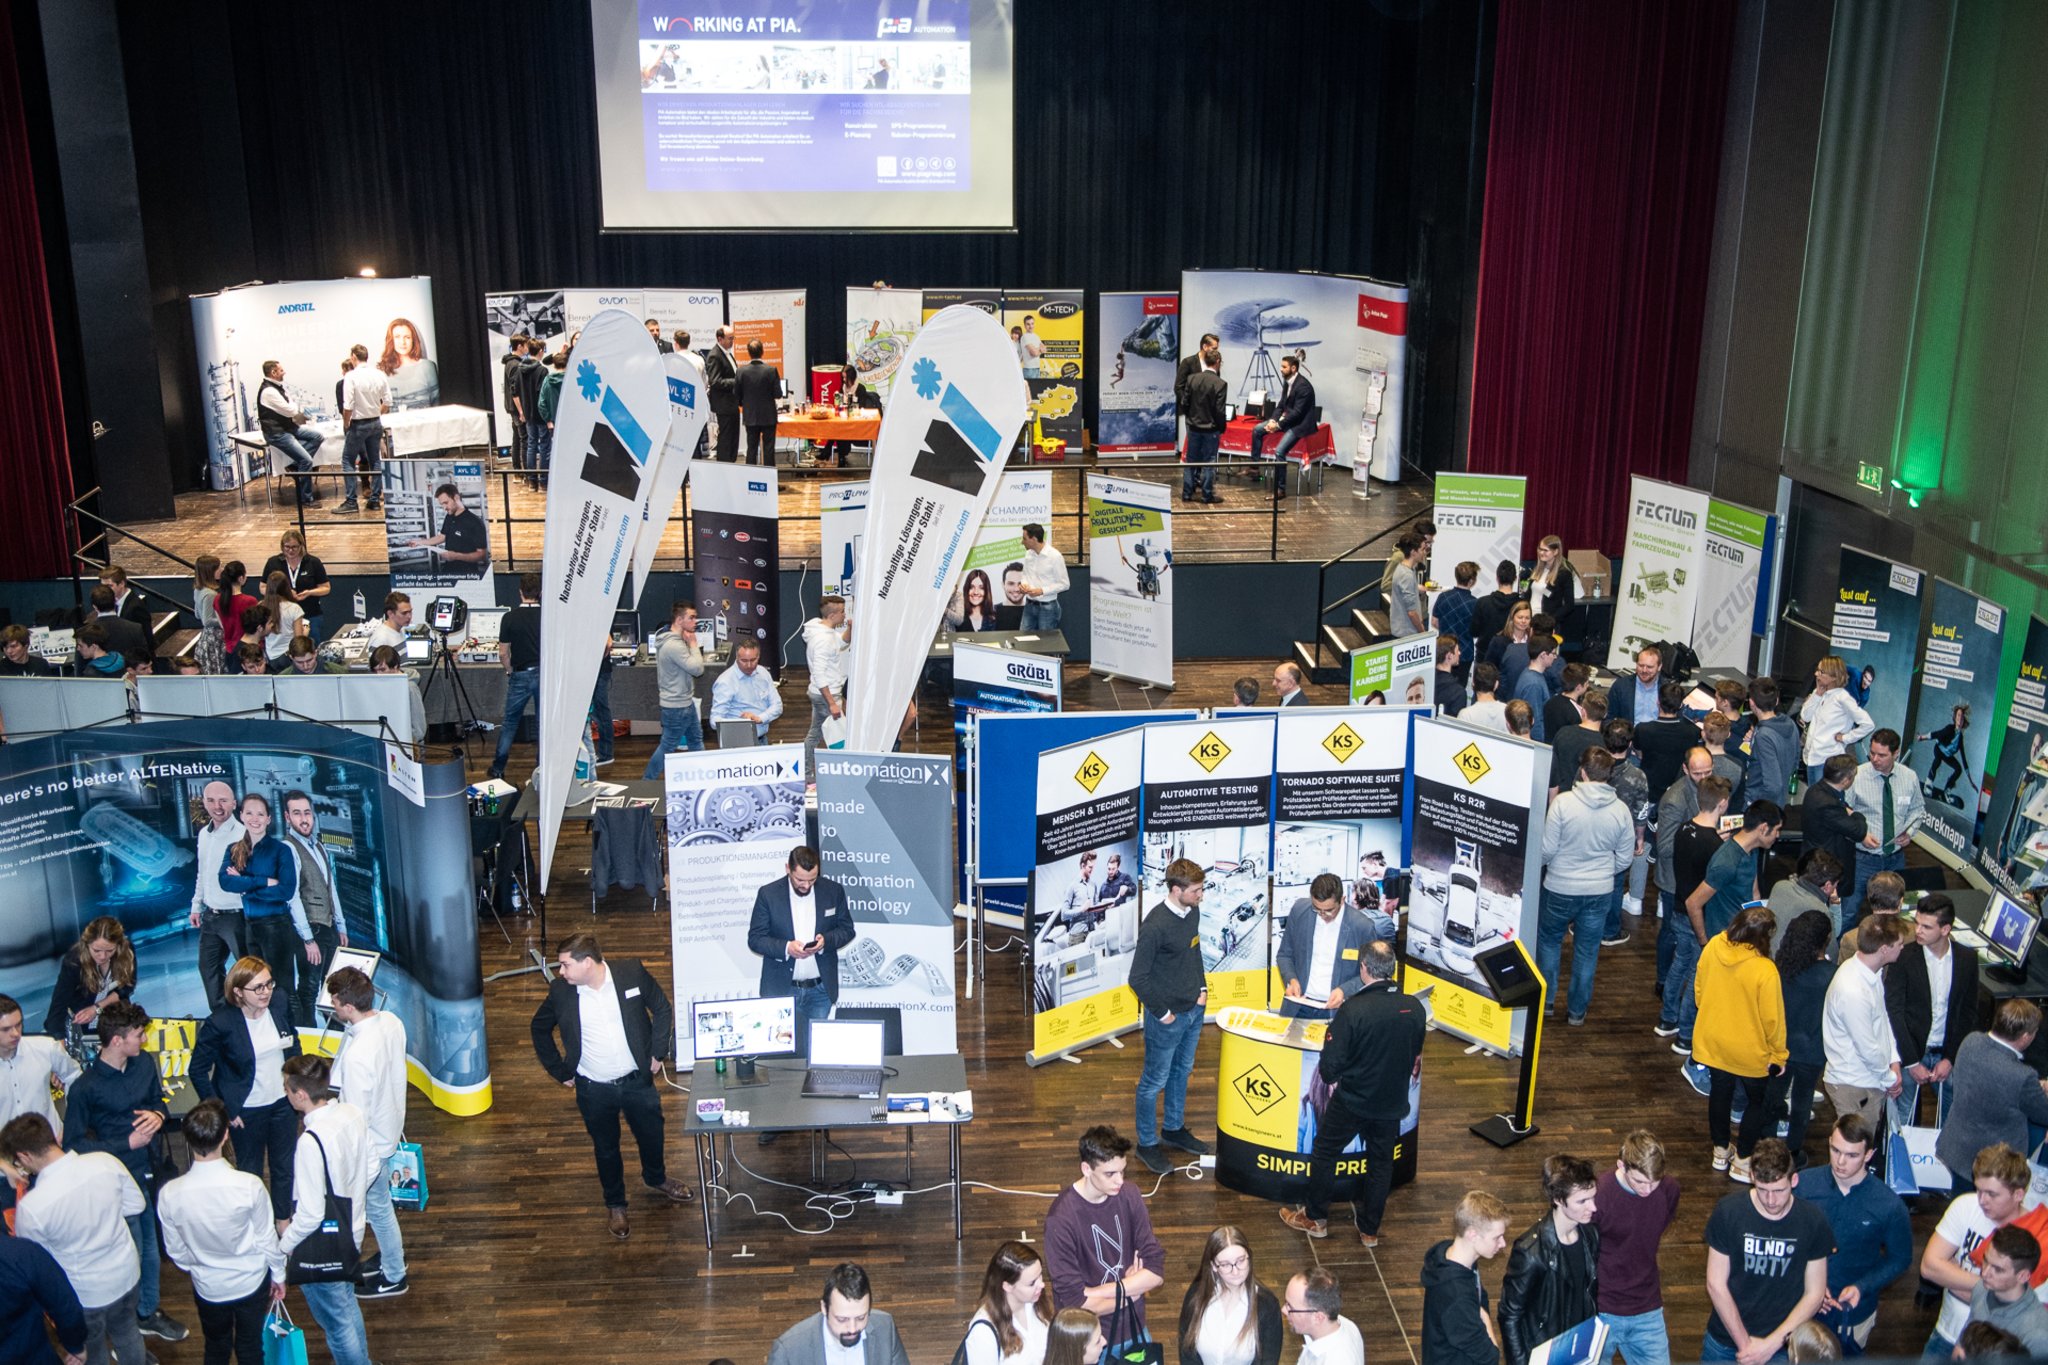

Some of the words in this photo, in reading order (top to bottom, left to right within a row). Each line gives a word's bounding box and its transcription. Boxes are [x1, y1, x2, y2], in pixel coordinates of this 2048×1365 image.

[746, 16, 765, 32] AT
[771, 16, 801, 32] PIA.
[278, 303, 315, 314] ANDRITZ
[1044, 305, 1074, 314] M-TECH
[992, 506, 1047, 515] CHAMPION?
[1095, 508, 1124, 516] DIGITALE
[1636, 500, 1698, 530] FECTUM
[1437, 513, 1496, 528] FECTUM
[901, 530, 925, 574] Härtester
[922, 501, 936, 528] Stahl.
[1099, 526, 1127, 534] GESUCHT
[577, 534, 595, 578] Härtester
[589, 505, 602, 532] Stahl.
[878, 544, 902, 600] Nachhaltige
[900, 496, 924, 543] Lösungen.
[1633, 531, 1685, 550] MASCHINENBAU
[559, 548, 578, 603] Nachhaltige
[574, 500, 592, 547] Lösungen.
[604, 515, 630, 595] winkelbauer.com
[933, 510, 970, 589] winkelbauer.com
[1632, 540, 1680, 559] FAHRZEUGBAU
[1706, 539, 1744, 564] FECTUM
[1892, 574, 1916, 585] KNAPP
[1978, 610, 1999, 624] KNAPP
[1365, 655, 1388, 667] STARTE
[1397, 645, 1431, 663] GRÜBL
[1007, 663, 1052, 682] GRÜBL
[1369, 664, 1387, 675] DEINE
[1356, 673, 1387, 686] KARRIERE
[980, 692, 1051, 710] AUTOMATISIERUNGSTECHNIK
[1332, 735, 1353, 749] KS
[1200, 743, 1220, 758] KS
[1462, 754, 1481, 771] KS
[47, 781, 68, 794] no
[72, 771, 125, 788] better
[129, 762, 226, 781] ALTENative.
[1083, 763, 1100, 780] KS
[1282, 777, 1324, 786] TORNADO
[1326, 776, 1373, 785] SOFTWARE
[1376, 774, 1400, 783] SUITE
[1160, 787, 1218, 799] AUTOMOTIVE
[1220, 785, 1258, 794] TESTING
[820, 800, 865, 814] made
[1453, 792, 1466, 803] KS
[1468, 796, 1486, 809] R2R
[39, 805, 75, 816] Mitarbeiter.
[1053, 808, 1085, 826] MENSCH
[1087, 806, 1094, 815] &
[1096, 796, 1130, 812] TECHNIK
[1153, 809, 1193, 818] Entwicklergeist
[1216, 805, 1264, 813] Automatisierungs-
[1193, 814, 1224, 822] ENGINEERS
[1249, 811, 1267, 819] gefragt.
[1289, 809, 1323, 817] Prüfaufgaben
[1419, 795, 1431, 803] From
[1432, 799, 1443, 807] Road
[1460, 807, 1475, 817] Testen
[1501, 821, 1519, 831] Straße,
[21, 819, 48, 829] Projekte.
[821, 824, 837, 838] to
[1920, 811, 1966, 851] eareknapp
[21, 829, 45, 838] Kunden.
[53, 829, 84, 839] Branchen.
[31, 841, 112, 862] Entwicklungsdienstleister.
[688, 850, 790, 865] PRODUKTIONSMANAGEME
[822, 849, 891, 864] measure
[847, 898, 912, 916] hnology
[1246, 1077, 1271, 1098] KS
[1233, 1122, 1282, 1139] www.ksengineers.at
[1257, 1153, 1310, 1177] SIMP
[1744, 1238, 1785, 1256] BLND
[1744, 1253, 1791, 1277] PRTY
